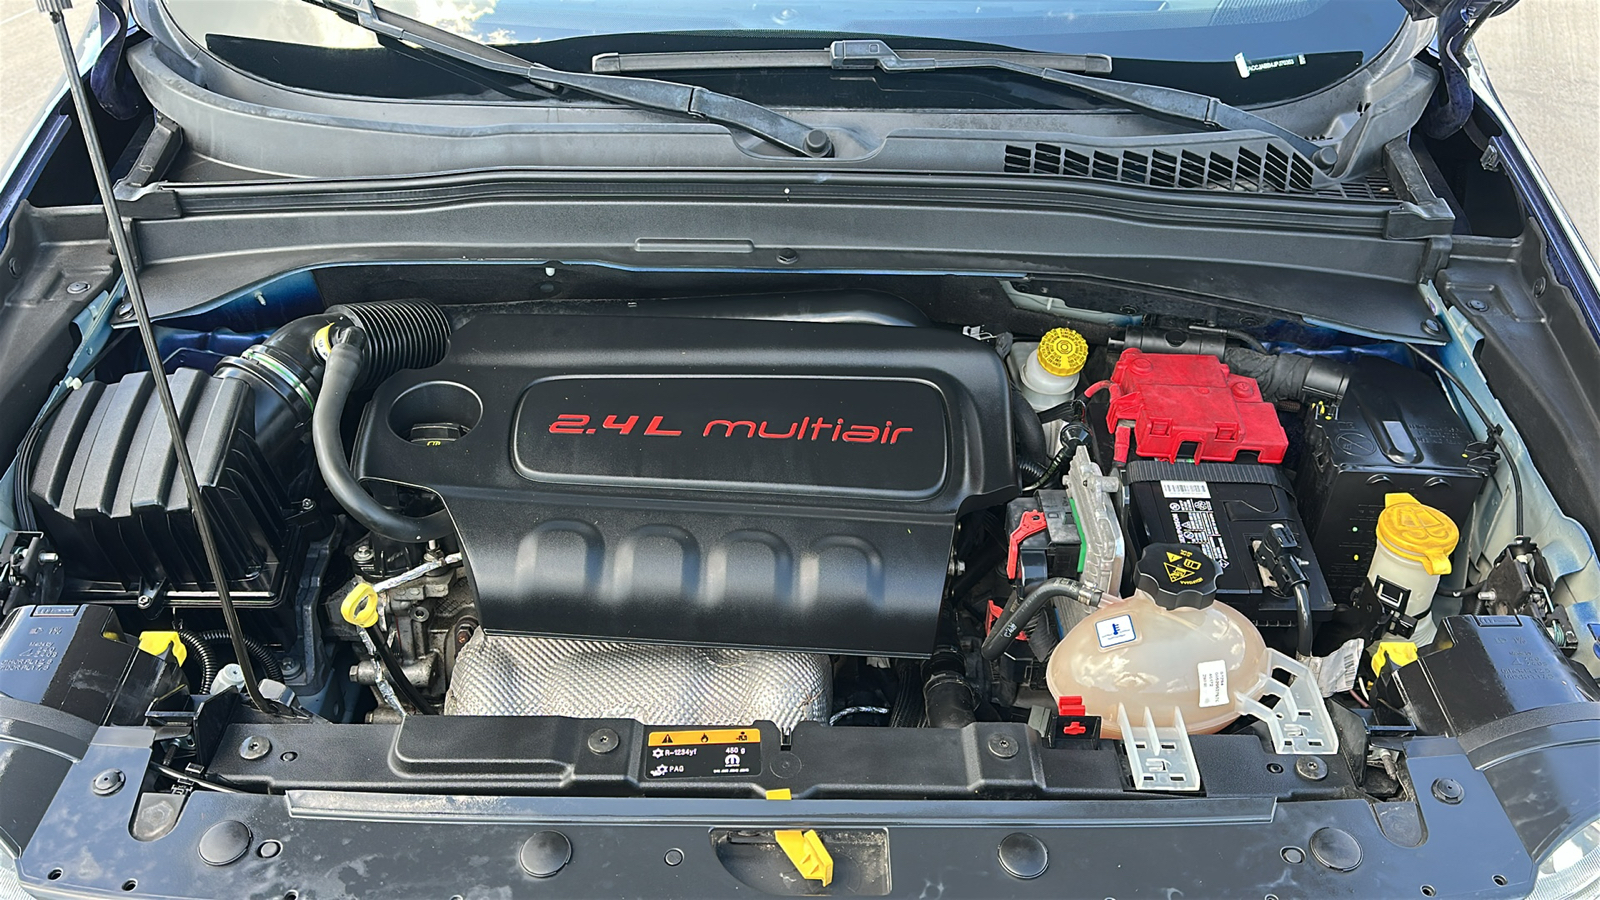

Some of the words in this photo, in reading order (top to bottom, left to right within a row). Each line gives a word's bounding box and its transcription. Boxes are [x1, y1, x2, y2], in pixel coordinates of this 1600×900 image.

[702, 416, 914, 444] multiair
[664, 748, 697, 756] R-1234yf
[725, 746, 739, 754] 450
[740, 747, 746, 755] g
